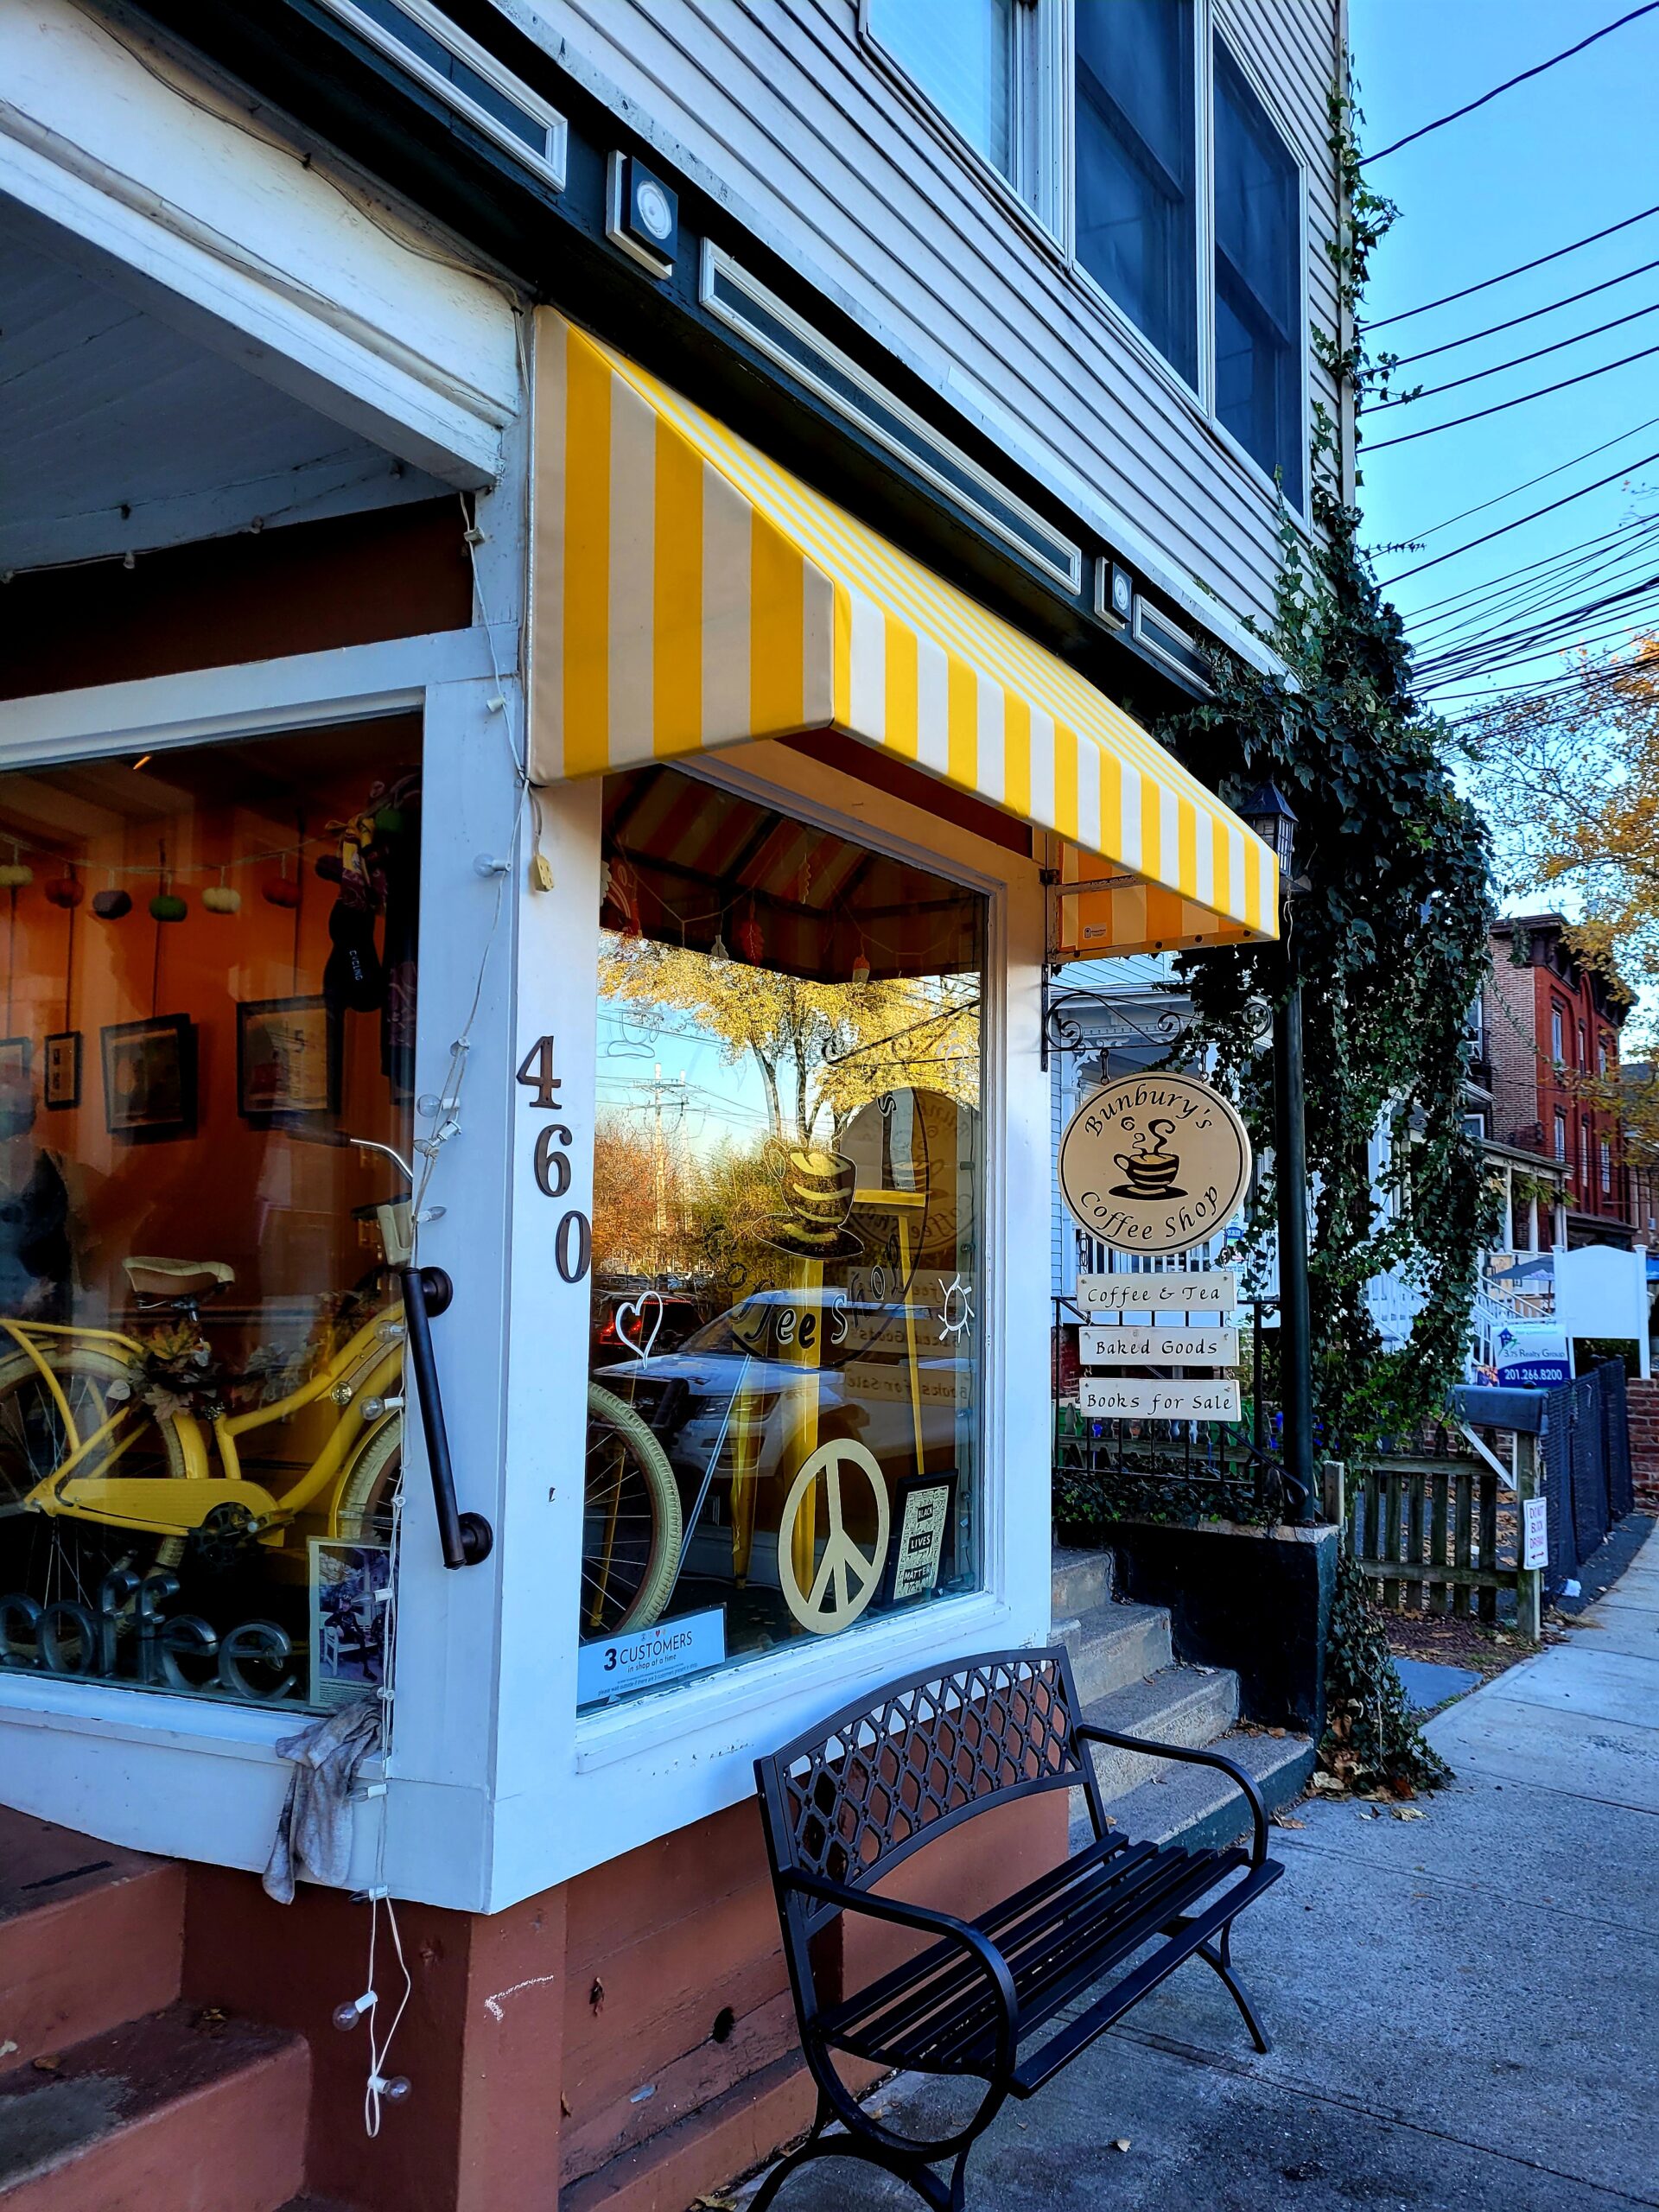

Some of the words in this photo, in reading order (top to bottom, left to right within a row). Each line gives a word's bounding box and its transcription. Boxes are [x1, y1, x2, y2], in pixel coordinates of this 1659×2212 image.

[1084, 1083, 1212, 1137] Bunbury's
[515, 1035, 591, 1283] 460
[1080, 1192, 1153, 1239] Coffee
[1165, 1185, 1217, 1238] Shop
[1088, 1286, 1151, 1308] Coffee
[1159, 1287, 1175, 1300] &
[1182, 1286, 1220, 1300] Tea
[1096, 1338, 1150, 1355] Baked
[1161, 1338, 1217, 1354] Goods
[1520, 1348, 1540, 1358] Realty
[1541, 1348, 1565, 1357] Group
[1504, 1369, 1563, 1381] 201.266.8200
[1087, 1393, 1140, 1408] Books
[1147, 1394, 1185, 1415] for
[1192, 1395, 1232, 1409] Sale
[918, 1506, 933, 1519] BLACK
[911, 1535, 931, 1550] LIVES
[604, 1648, 617, 1671] 3
[620, 1630, 692, 1665] CUSTOMERS
[627, 1664, 634, 1674] in
[636, 1661, 650, 1672] shop
[652, 1658, 658, 1667] at
[664, 1653, 677, 1663] time
